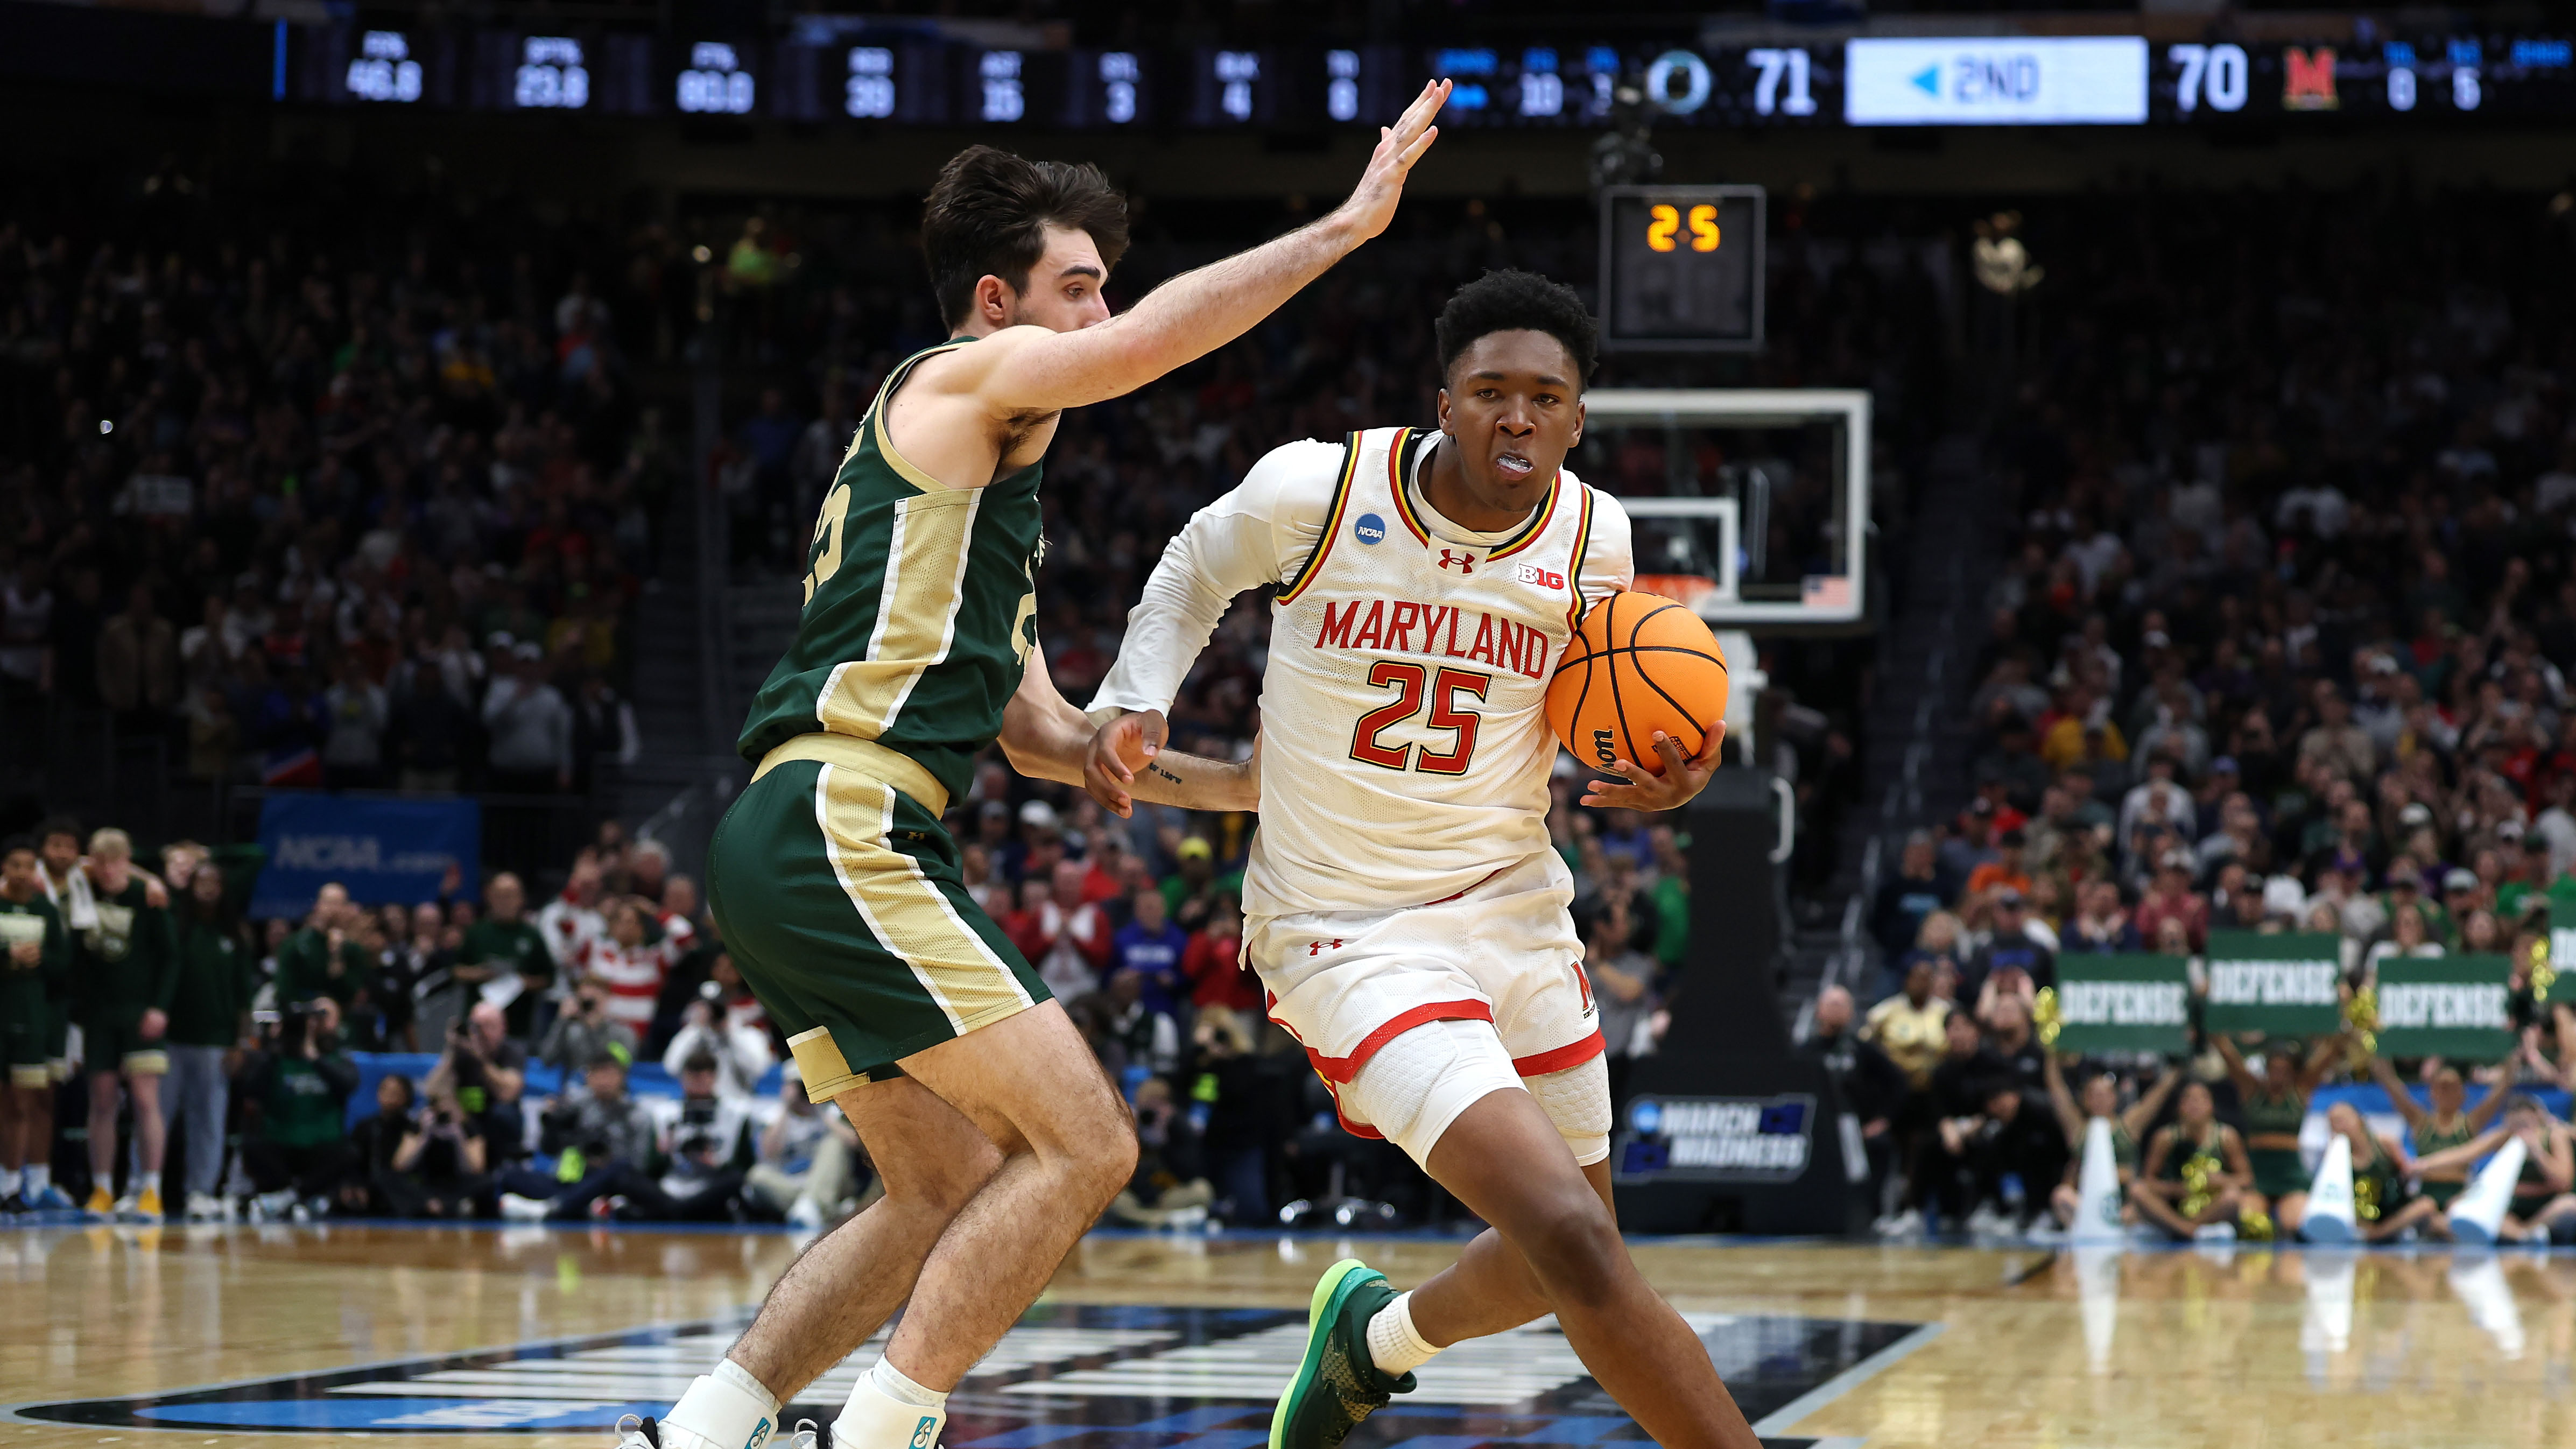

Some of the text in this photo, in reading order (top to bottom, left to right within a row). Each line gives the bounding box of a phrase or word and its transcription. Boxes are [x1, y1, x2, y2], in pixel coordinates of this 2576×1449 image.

[1747, 48, 1817, 116] 71
[1953, 53, 2042, 101] 2ND
[2169, 44, 2248, 111] 70
[1358, 526, 1383, 539] NCAA
[1315, 600, 1549, 680] MARYLAND
[1349, 660, 1493, 776] 25
[2059, 982, 2187, 1025] DEFENSE
[2208, 961, 2339, 1004] DEFENSE
[2380, 983, 2509, 1028] DEFENSE
[1670, 1134, 1807, 1168] MADNESS
